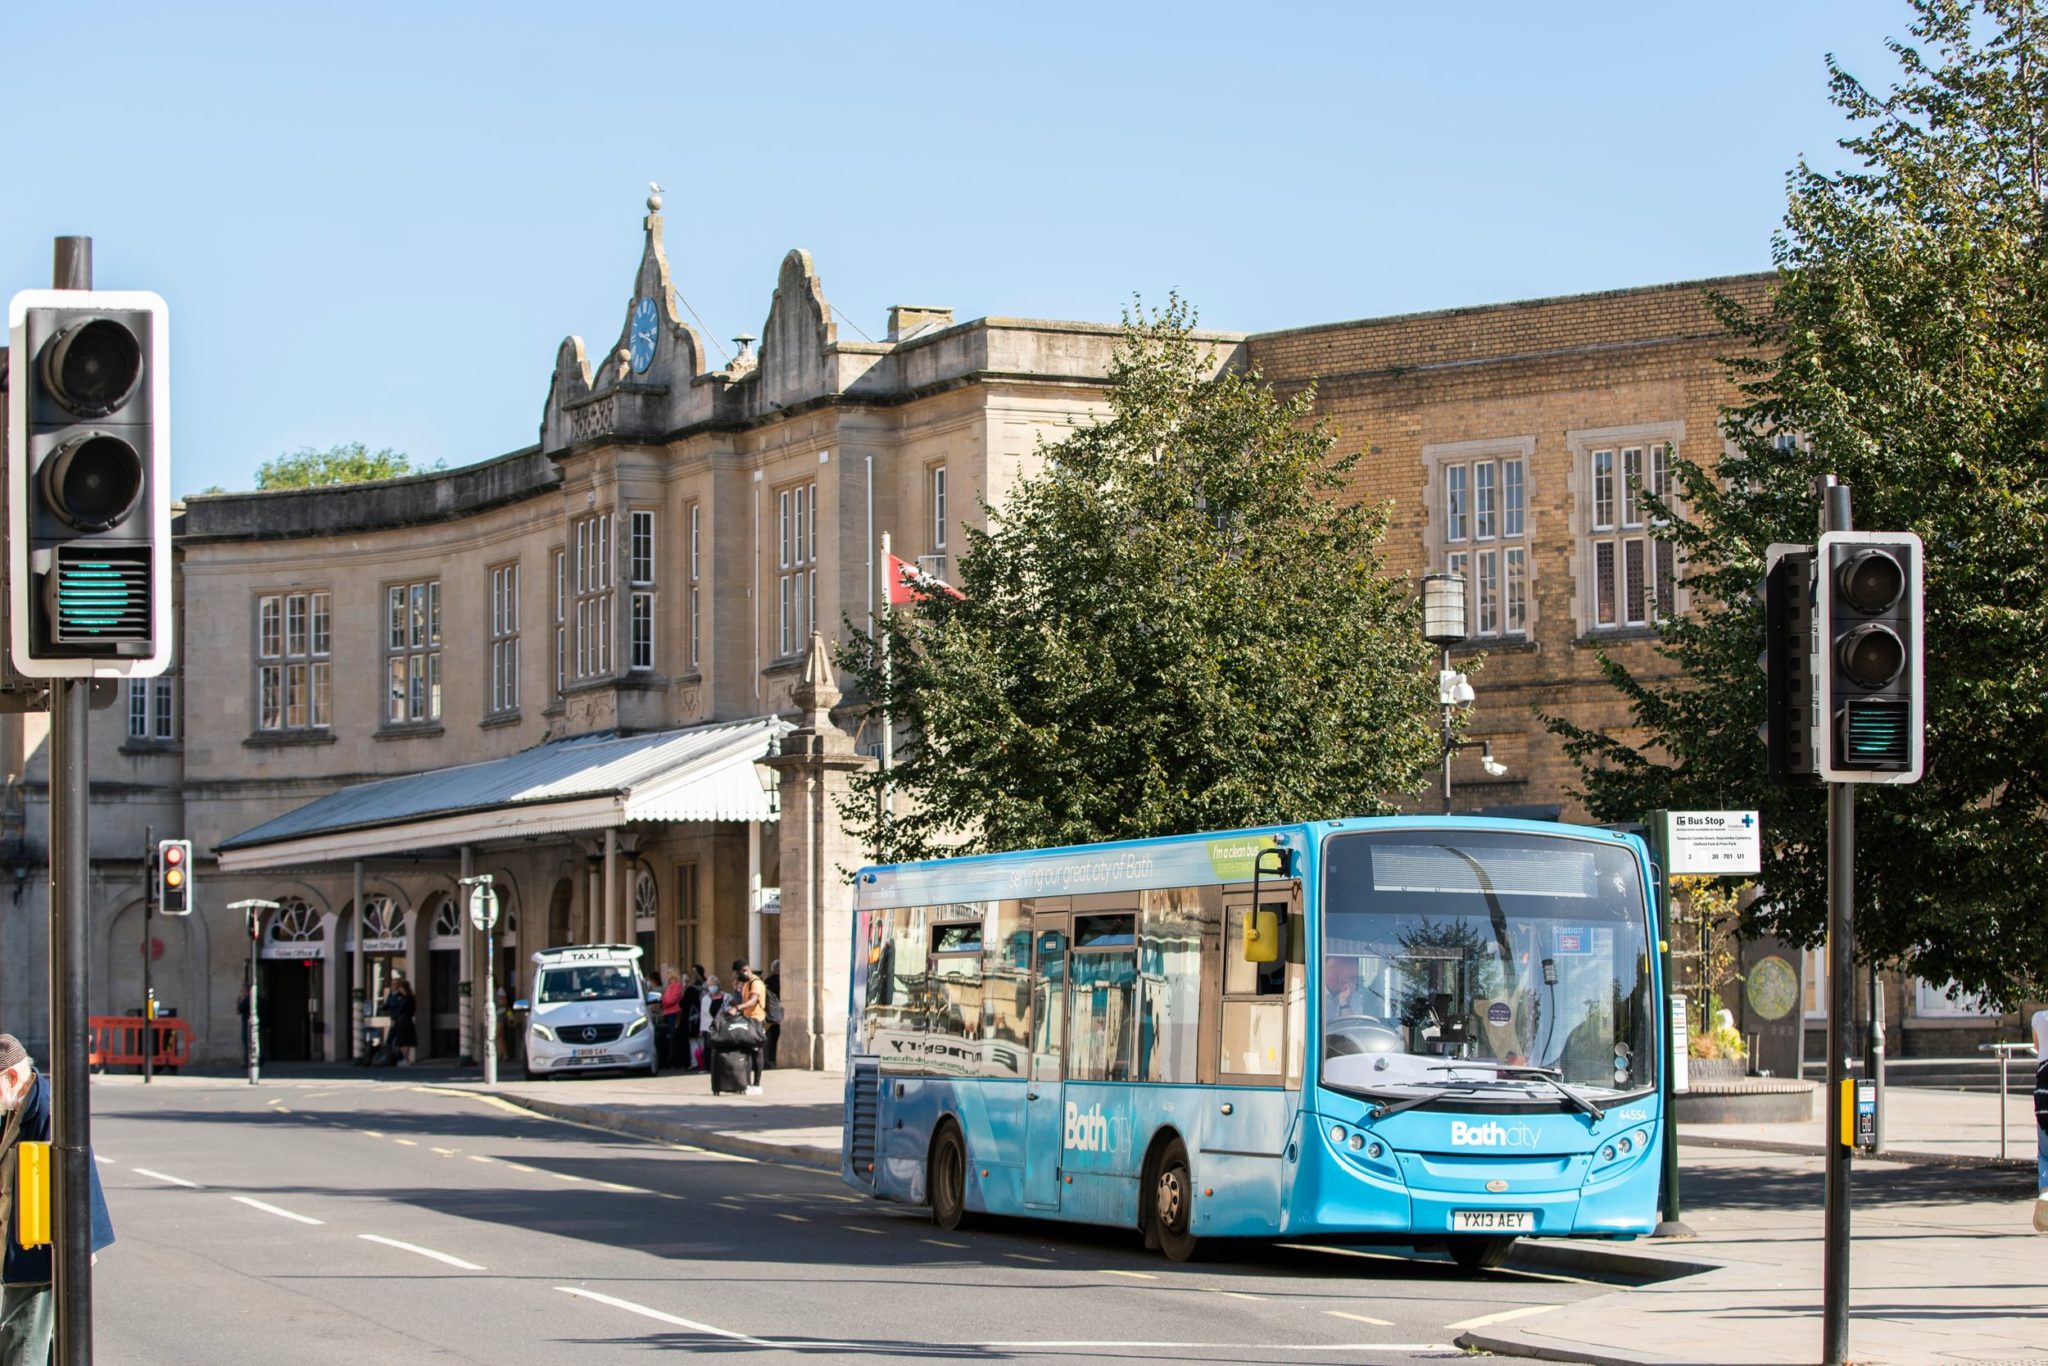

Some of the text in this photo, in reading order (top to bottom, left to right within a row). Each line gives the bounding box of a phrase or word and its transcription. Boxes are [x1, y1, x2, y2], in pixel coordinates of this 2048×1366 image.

[1688, 816, 1725, 827] Bus Stop
[1213, 842, 1259, 860] I'm a clean bus
[1009, 852, 1153, 892] serving our great city of Bath
[1859, 1103, 1874, 1113] WAIT
[1619, 1109, 1647, 1121] 44554
[1463, 1213, 1525, 1227] YX13 AEY
